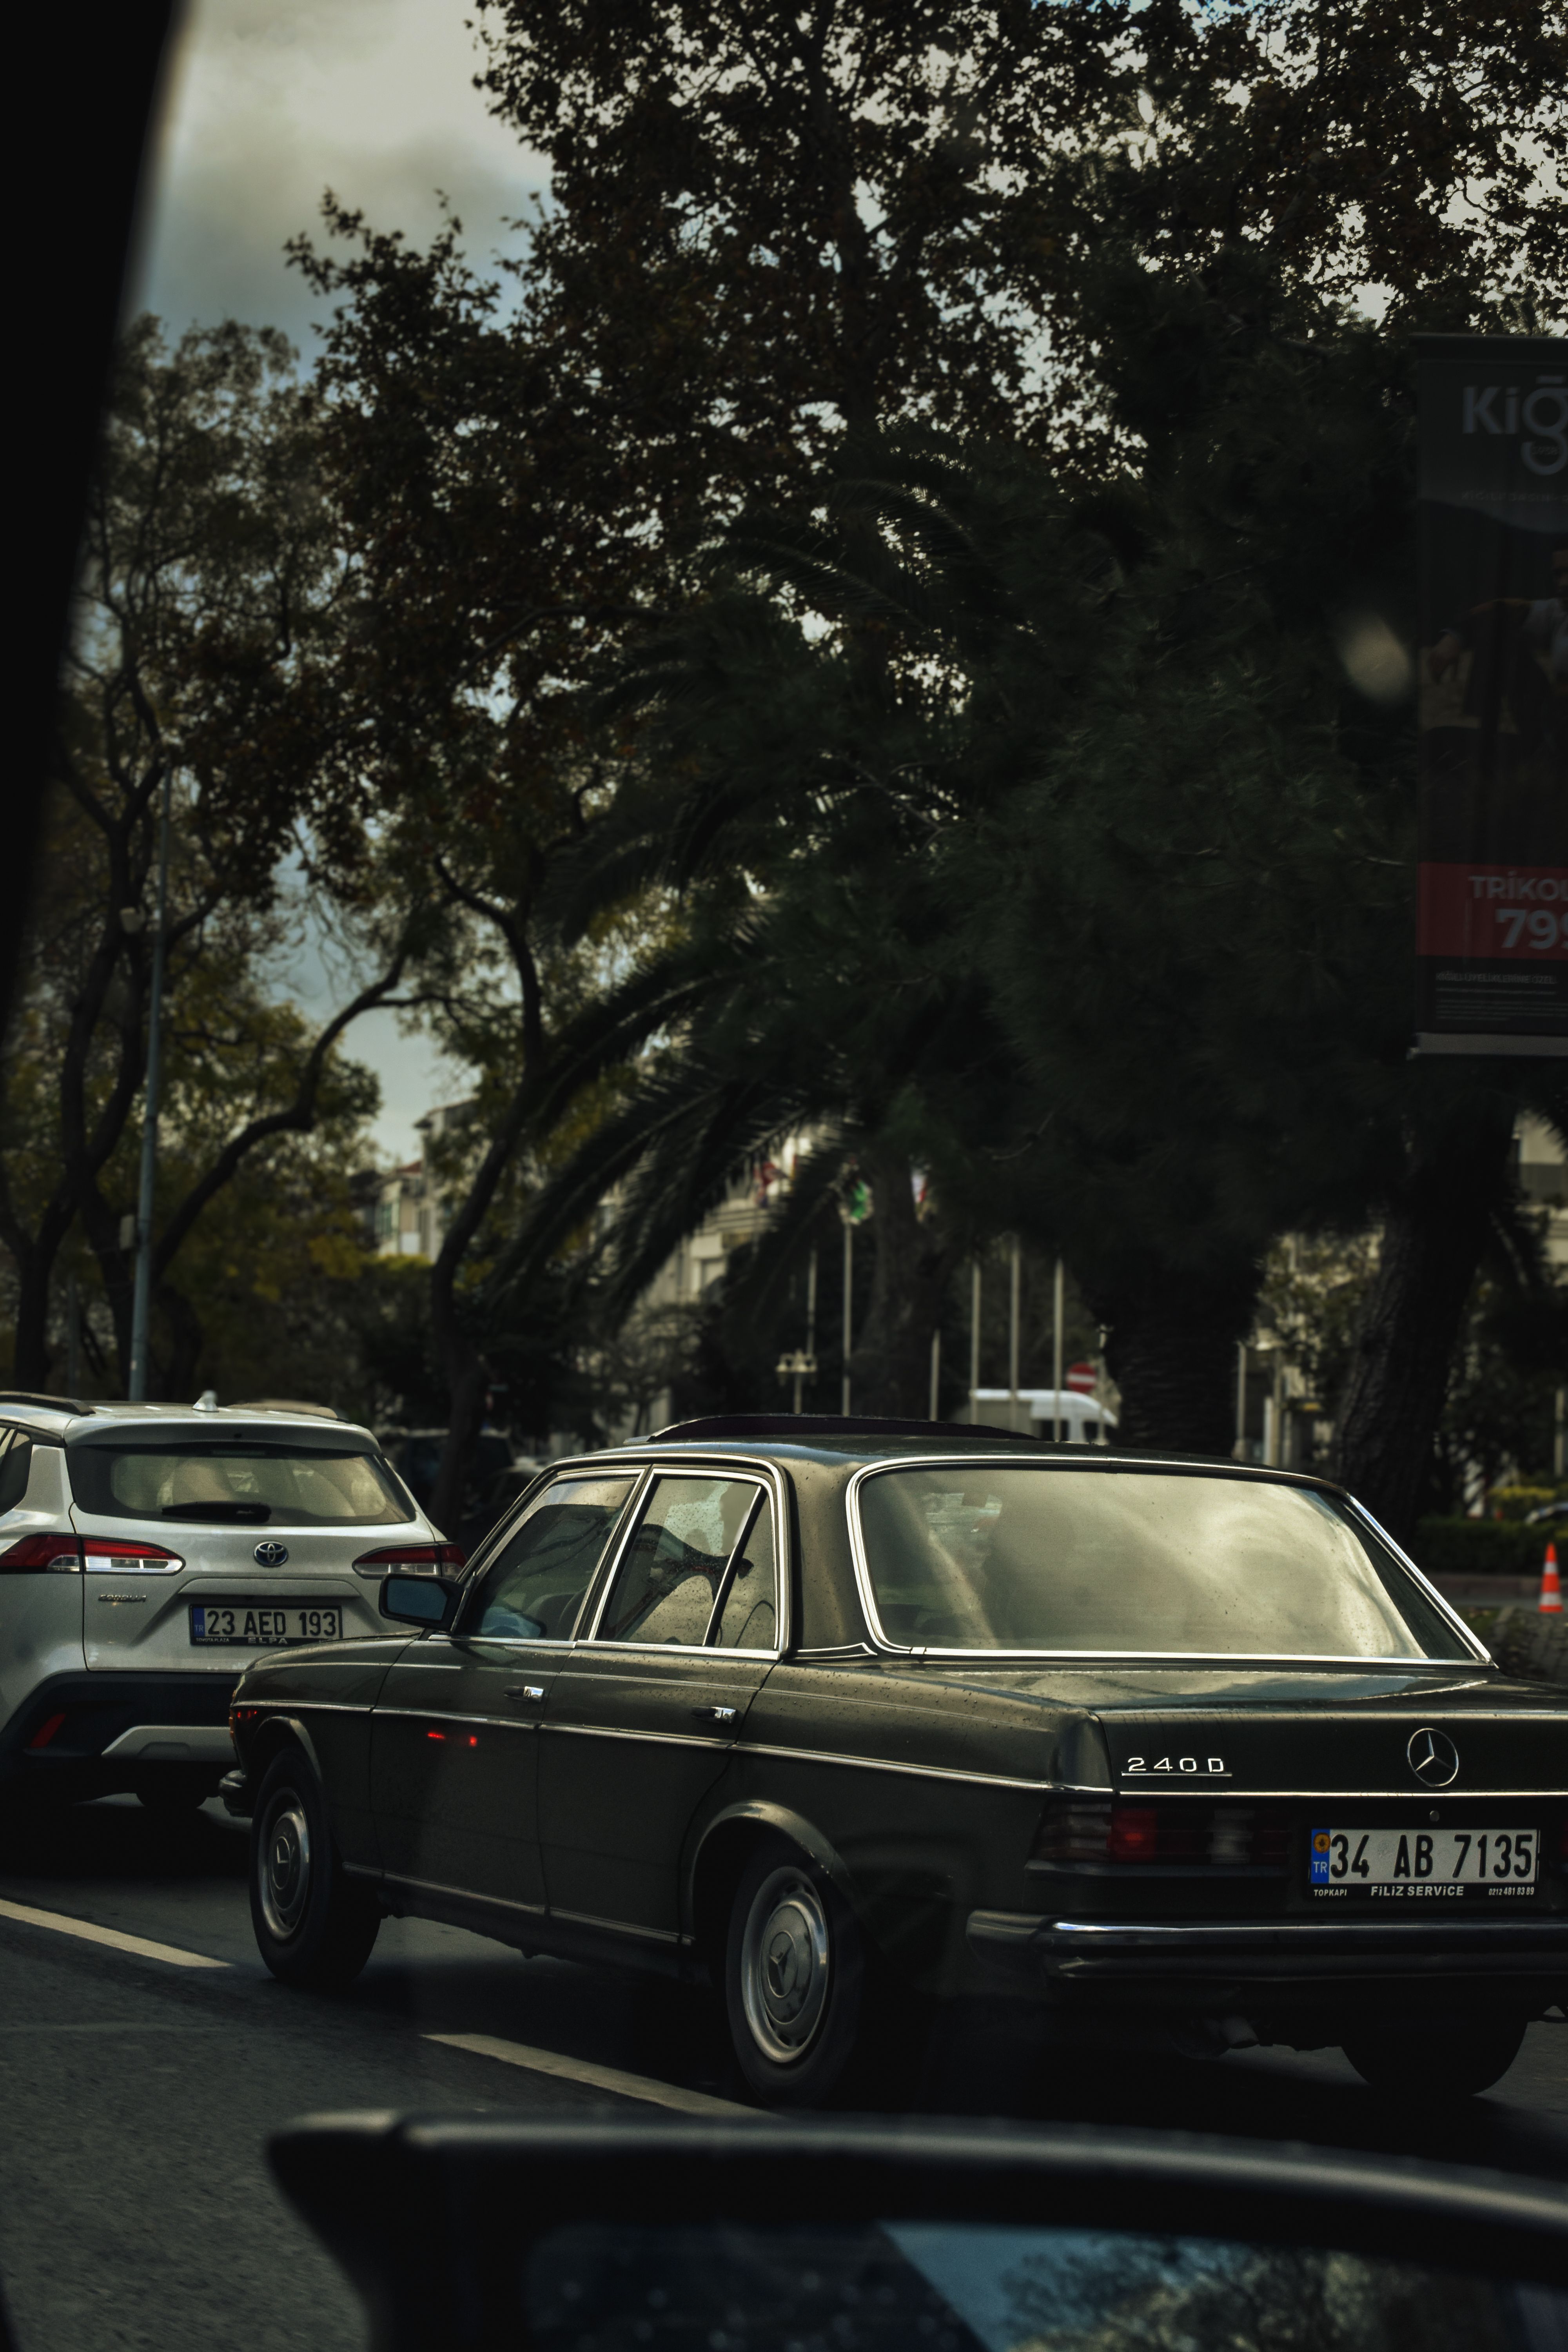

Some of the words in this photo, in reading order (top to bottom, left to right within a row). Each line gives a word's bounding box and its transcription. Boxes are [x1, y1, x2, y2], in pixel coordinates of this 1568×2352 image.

[207, 1610, 235, 1635] 23
[244, 1611, 286, 1635] AED
[299, 1611, 336, 1636] 193
[1330, 1834, 1370, 1878] 34
[1393, 1835, 1434, 1878] AB
[1452, 1834, 1533, 1878] 7135
[1313, 1861, 1327, 1873] TR
[1503, 1887, 1515, 1896] 481
[1517, 1887, 1525, 1895] 83
[1526, 1886, 1534, 1895] 89
